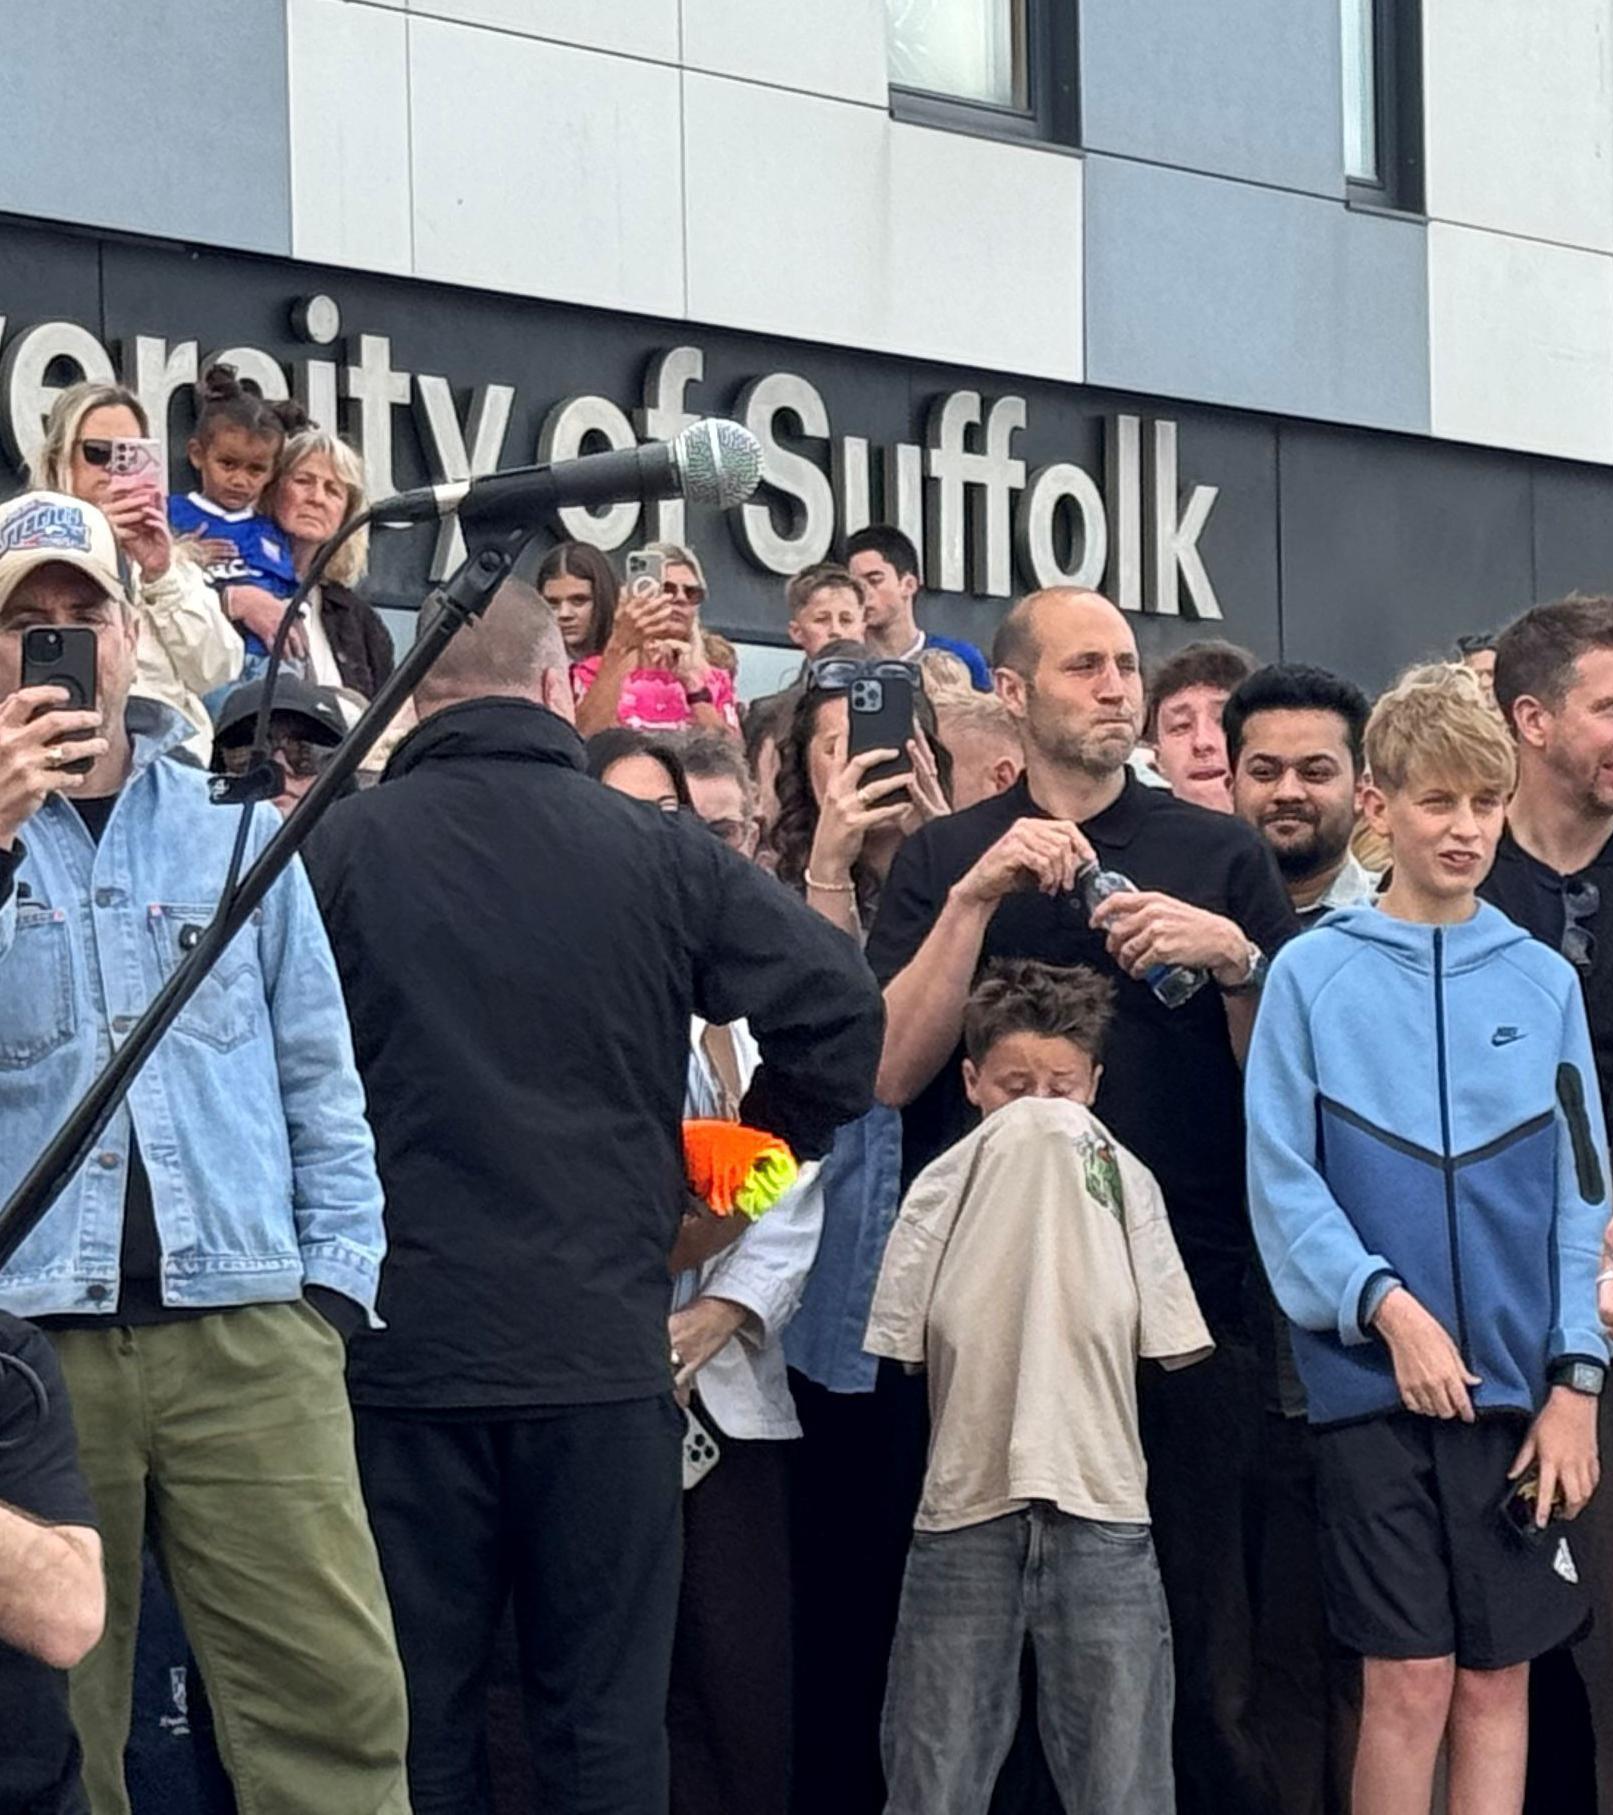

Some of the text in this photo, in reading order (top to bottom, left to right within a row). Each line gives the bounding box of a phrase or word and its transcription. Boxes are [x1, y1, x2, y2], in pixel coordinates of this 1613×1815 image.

[0, 293, 1224, 619] erity of Suffolk
